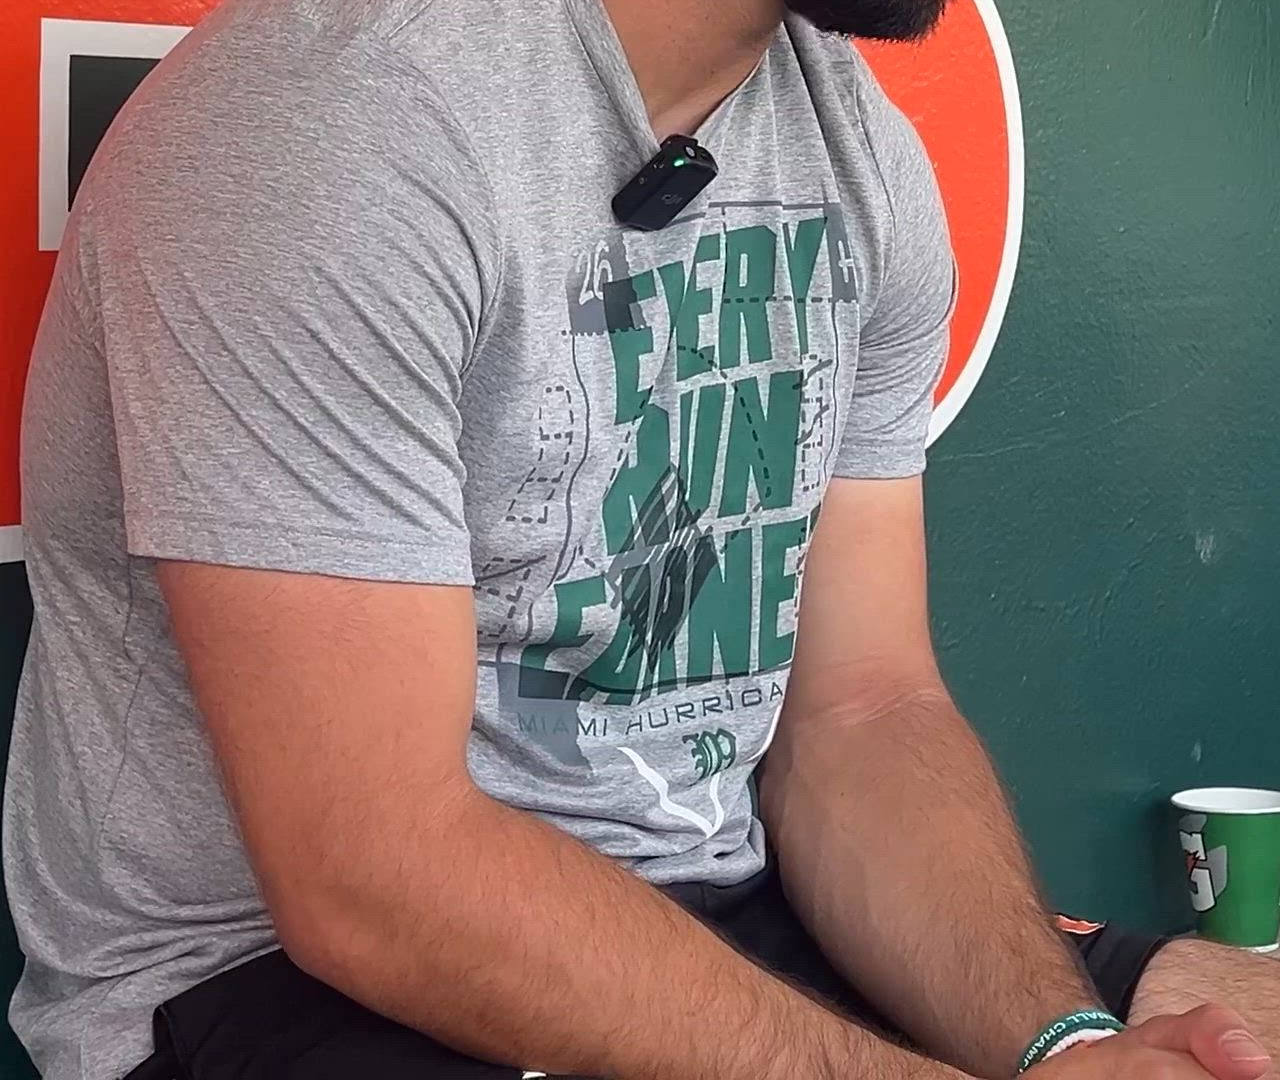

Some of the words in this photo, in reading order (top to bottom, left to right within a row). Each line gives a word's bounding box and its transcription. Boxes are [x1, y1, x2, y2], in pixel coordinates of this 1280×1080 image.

[604, 217, 826, 425] EVERY
[602, 369, 804, 556] RUN
[517, 711, 608, 737] MIAMI
[625, 681, 784, 736] HURRICA
